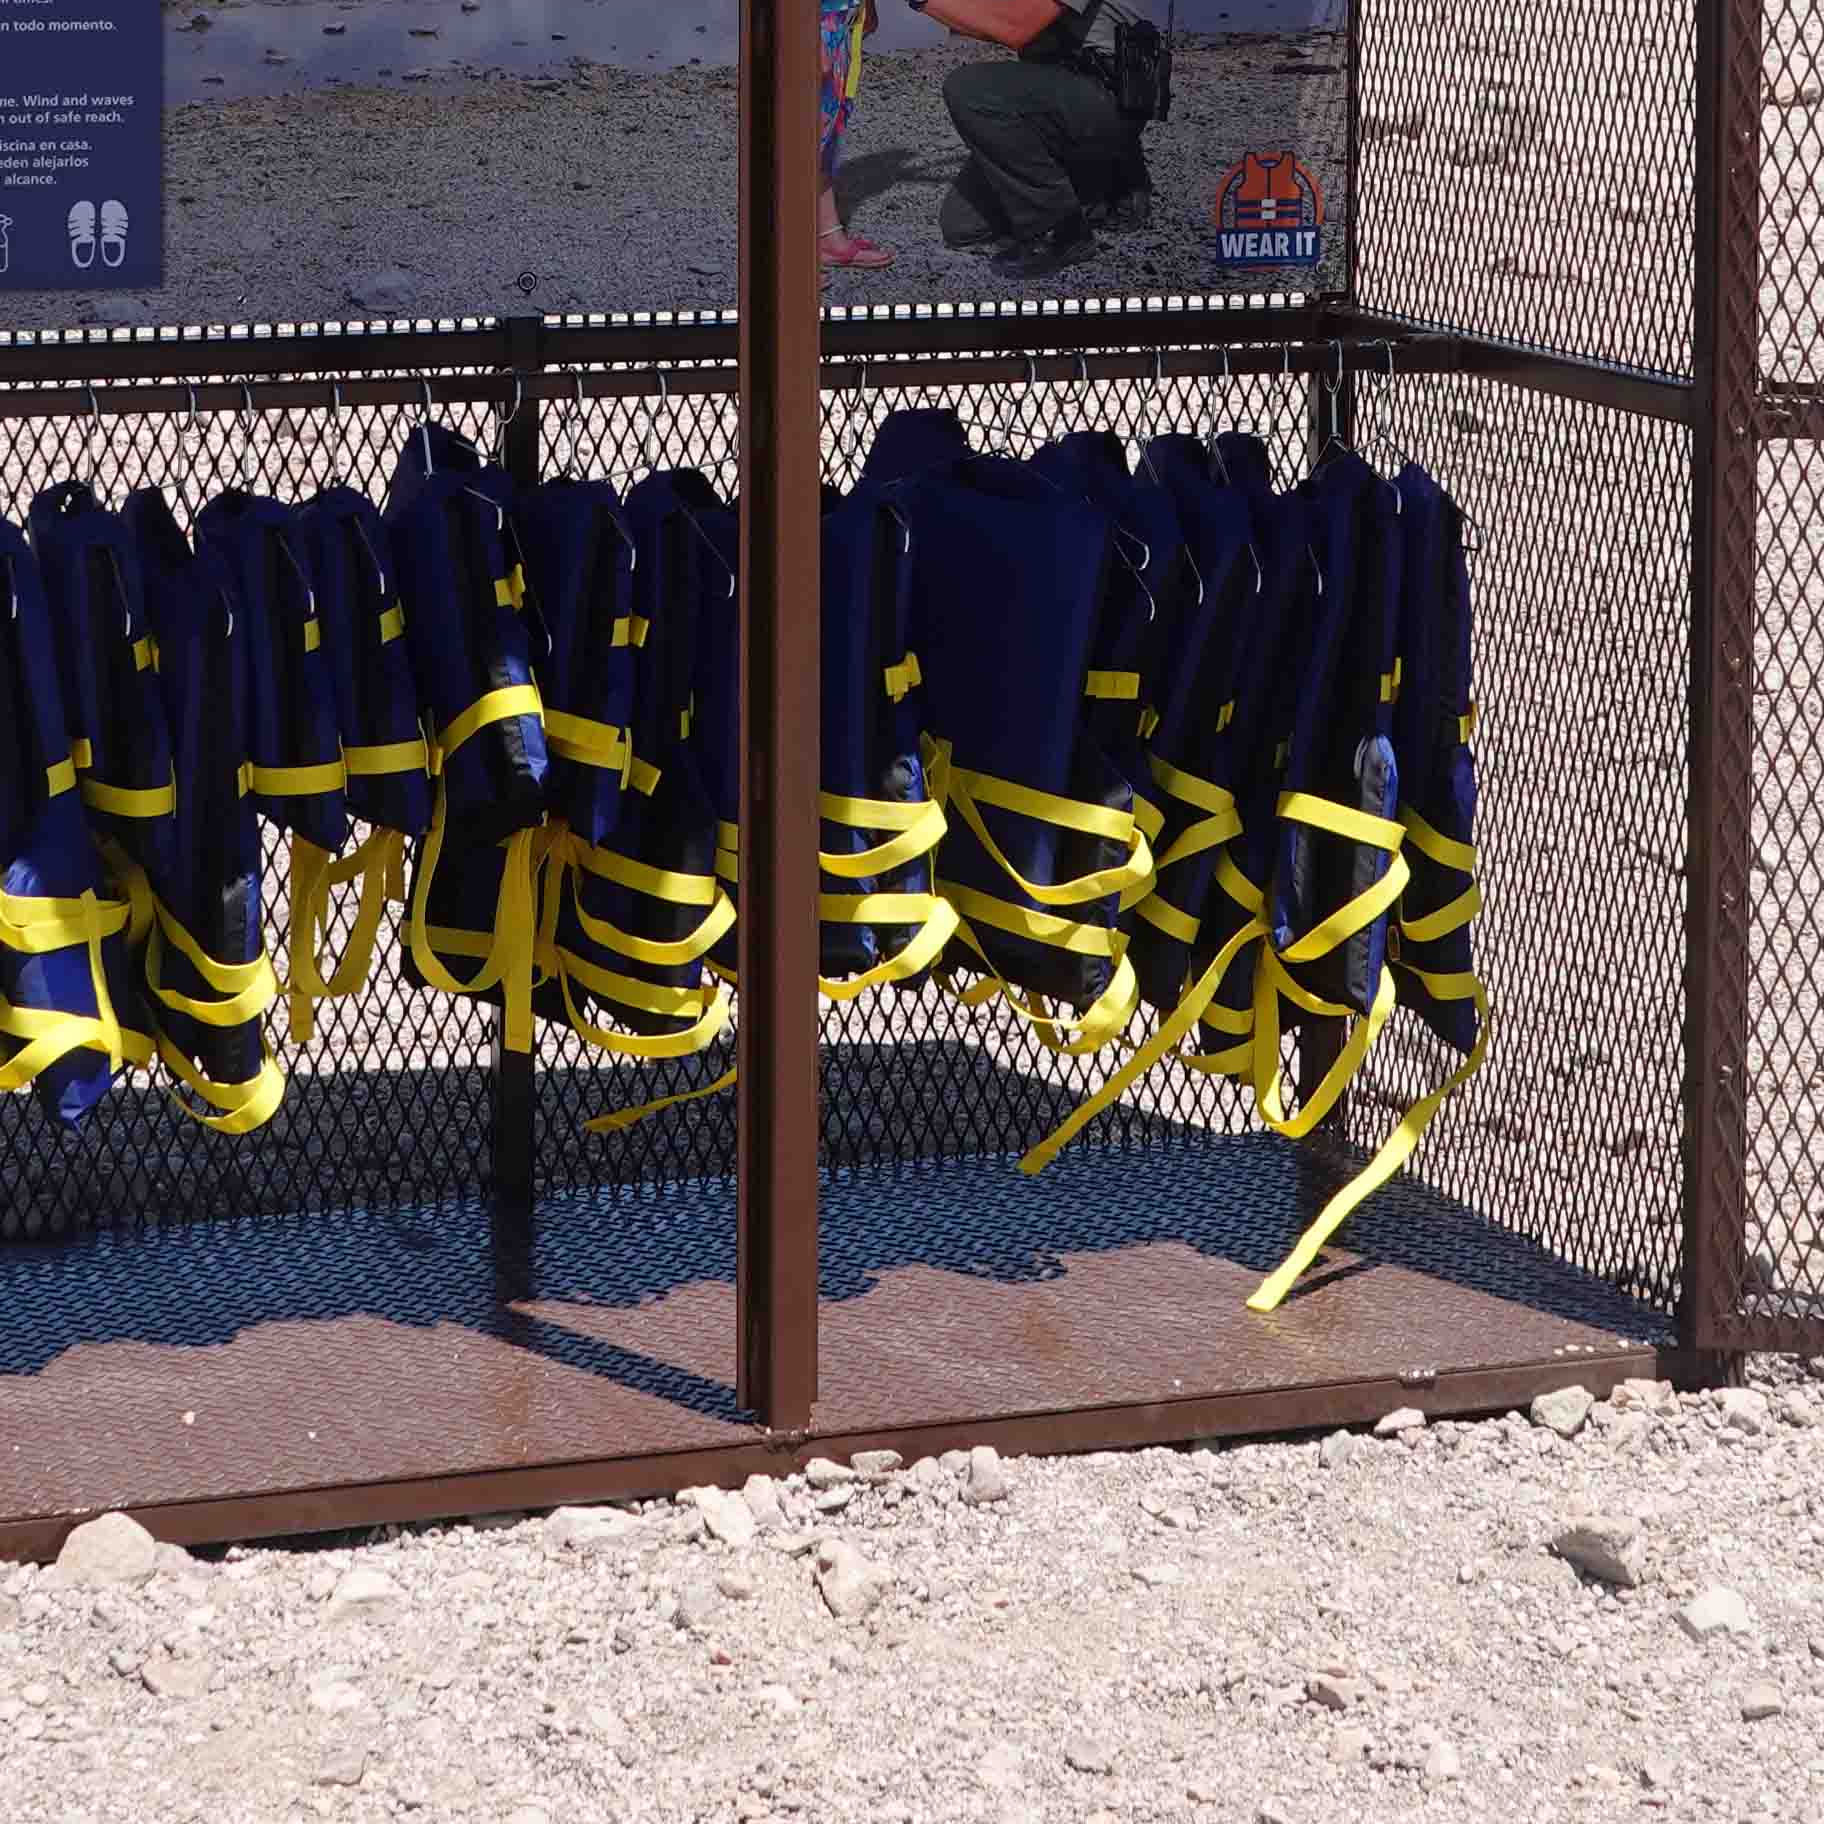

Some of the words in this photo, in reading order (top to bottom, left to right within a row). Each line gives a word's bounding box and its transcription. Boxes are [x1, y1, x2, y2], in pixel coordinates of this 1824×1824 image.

[13, 20, 45, 31] todo
[49, 20, 116, 30] momento.
[23, 95, 58, 106] Wind
[62, 94, 87, 105] and
[91, 96, 133, 105] waves
[9, 114, 31, 124] out
[35, 111, 50, 123] of
[54, 110, 81, 123] safe
[86, 111, 124, 122] reach.
[40, 142, 56, 150] en
[60, 141, 92, 150] casa.
[33, 155, 88, 170] alejarlos
[5, 173, 56, 184] alcance.
[1221, 232, 1289, 258] WEAR
[1296, 232, 1315, 256] IT
